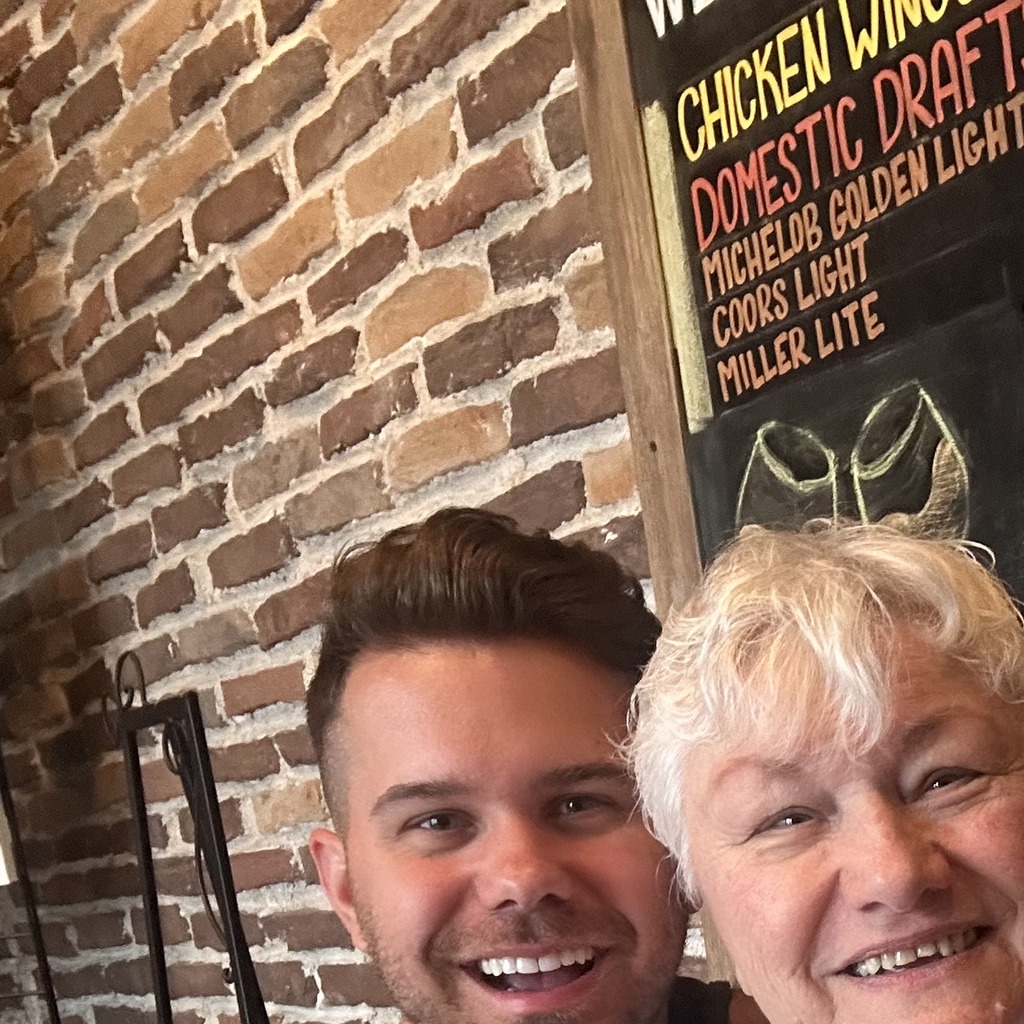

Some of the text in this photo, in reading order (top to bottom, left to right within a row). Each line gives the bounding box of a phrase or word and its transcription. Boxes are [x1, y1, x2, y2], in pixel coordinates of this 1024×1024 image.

[677, 8, 831, 163] CHICKEN
[690, 96, 863, 252] DOMESTIC
[702, 202, 823, 302] MICHELOB
[829, 143, 928, 235] GOLDEN
[712, 231, 870, 349] COORS LIGHT
[716, 290, 886, 402] MILLER LITE
